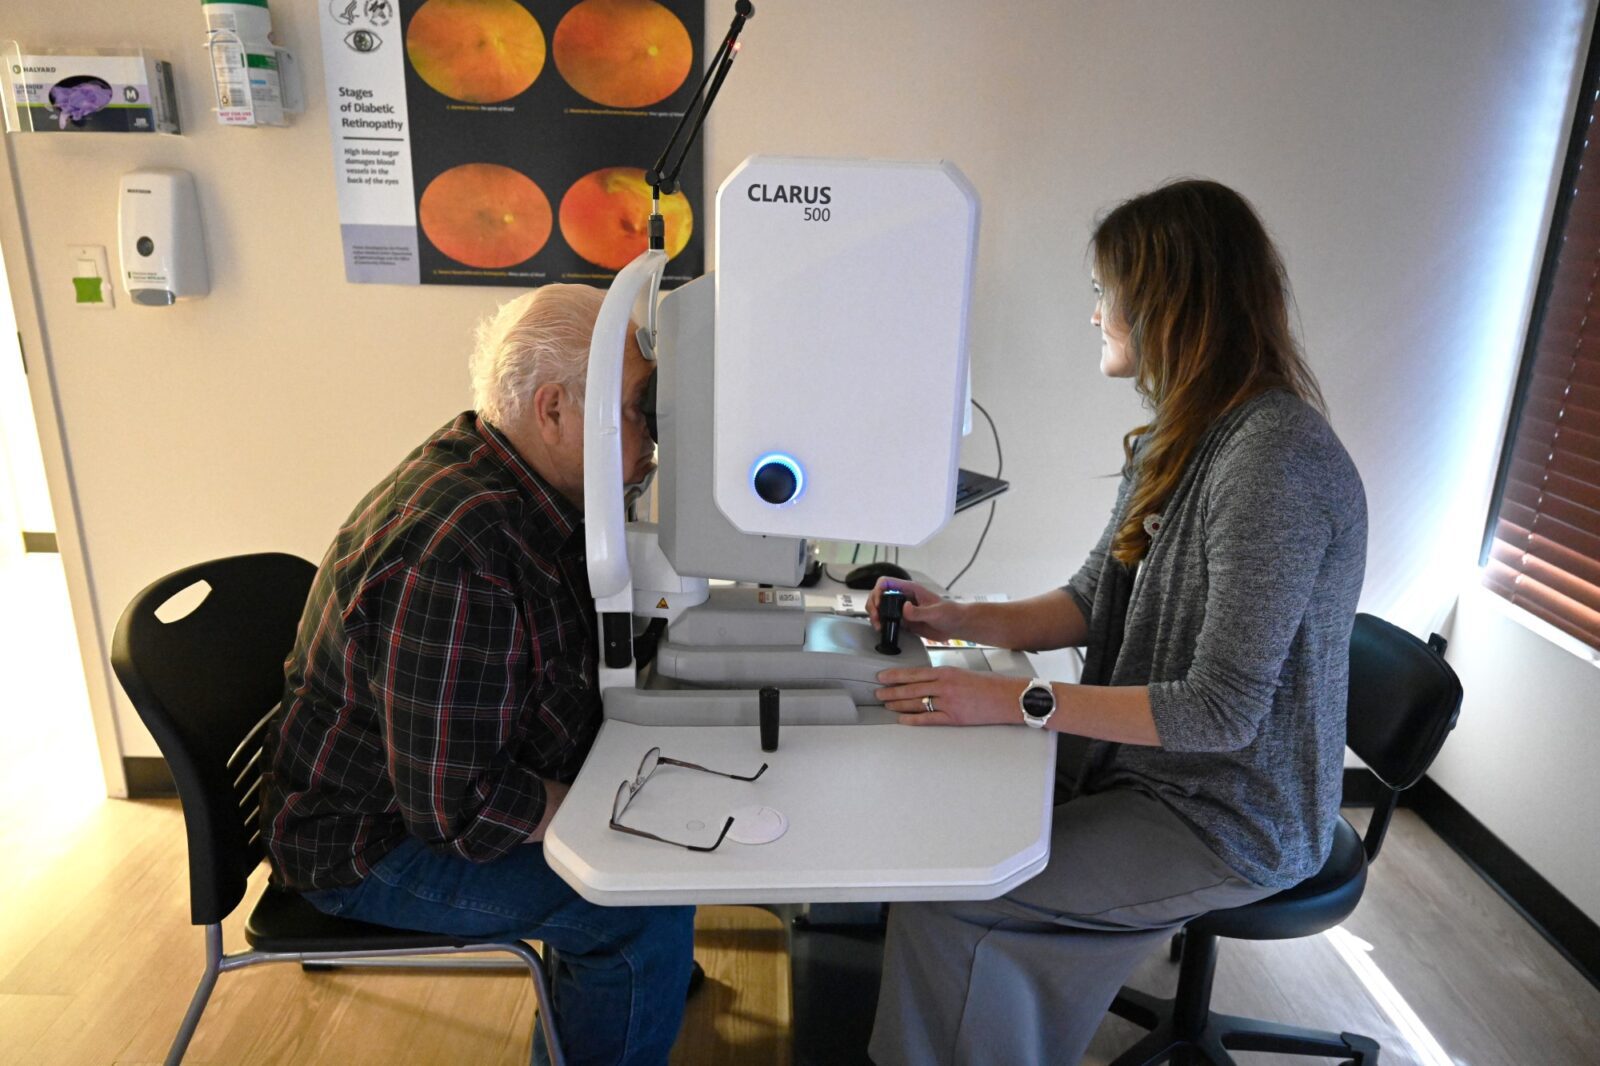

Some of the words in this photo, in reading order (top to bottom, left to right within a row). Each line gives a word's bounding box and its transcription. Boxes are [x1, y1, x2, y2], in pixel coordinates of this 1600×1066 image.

[126, 90, 137, 100] M
[338, 87, 373, 100] Stages
[340, 103, 352, 112] of
[354, 103, 395, 114] Diabetic
[342, 118, 403, 131] Retinopathy
[344, 148, 360, 156] High
[361, 148, 380, 156] blood
[345, 158, 375, 166] damages
[377, 158, 395, 166] blood
[747, 183, 831, 205] CLARUS
[803, 207, 831, 222] 500
